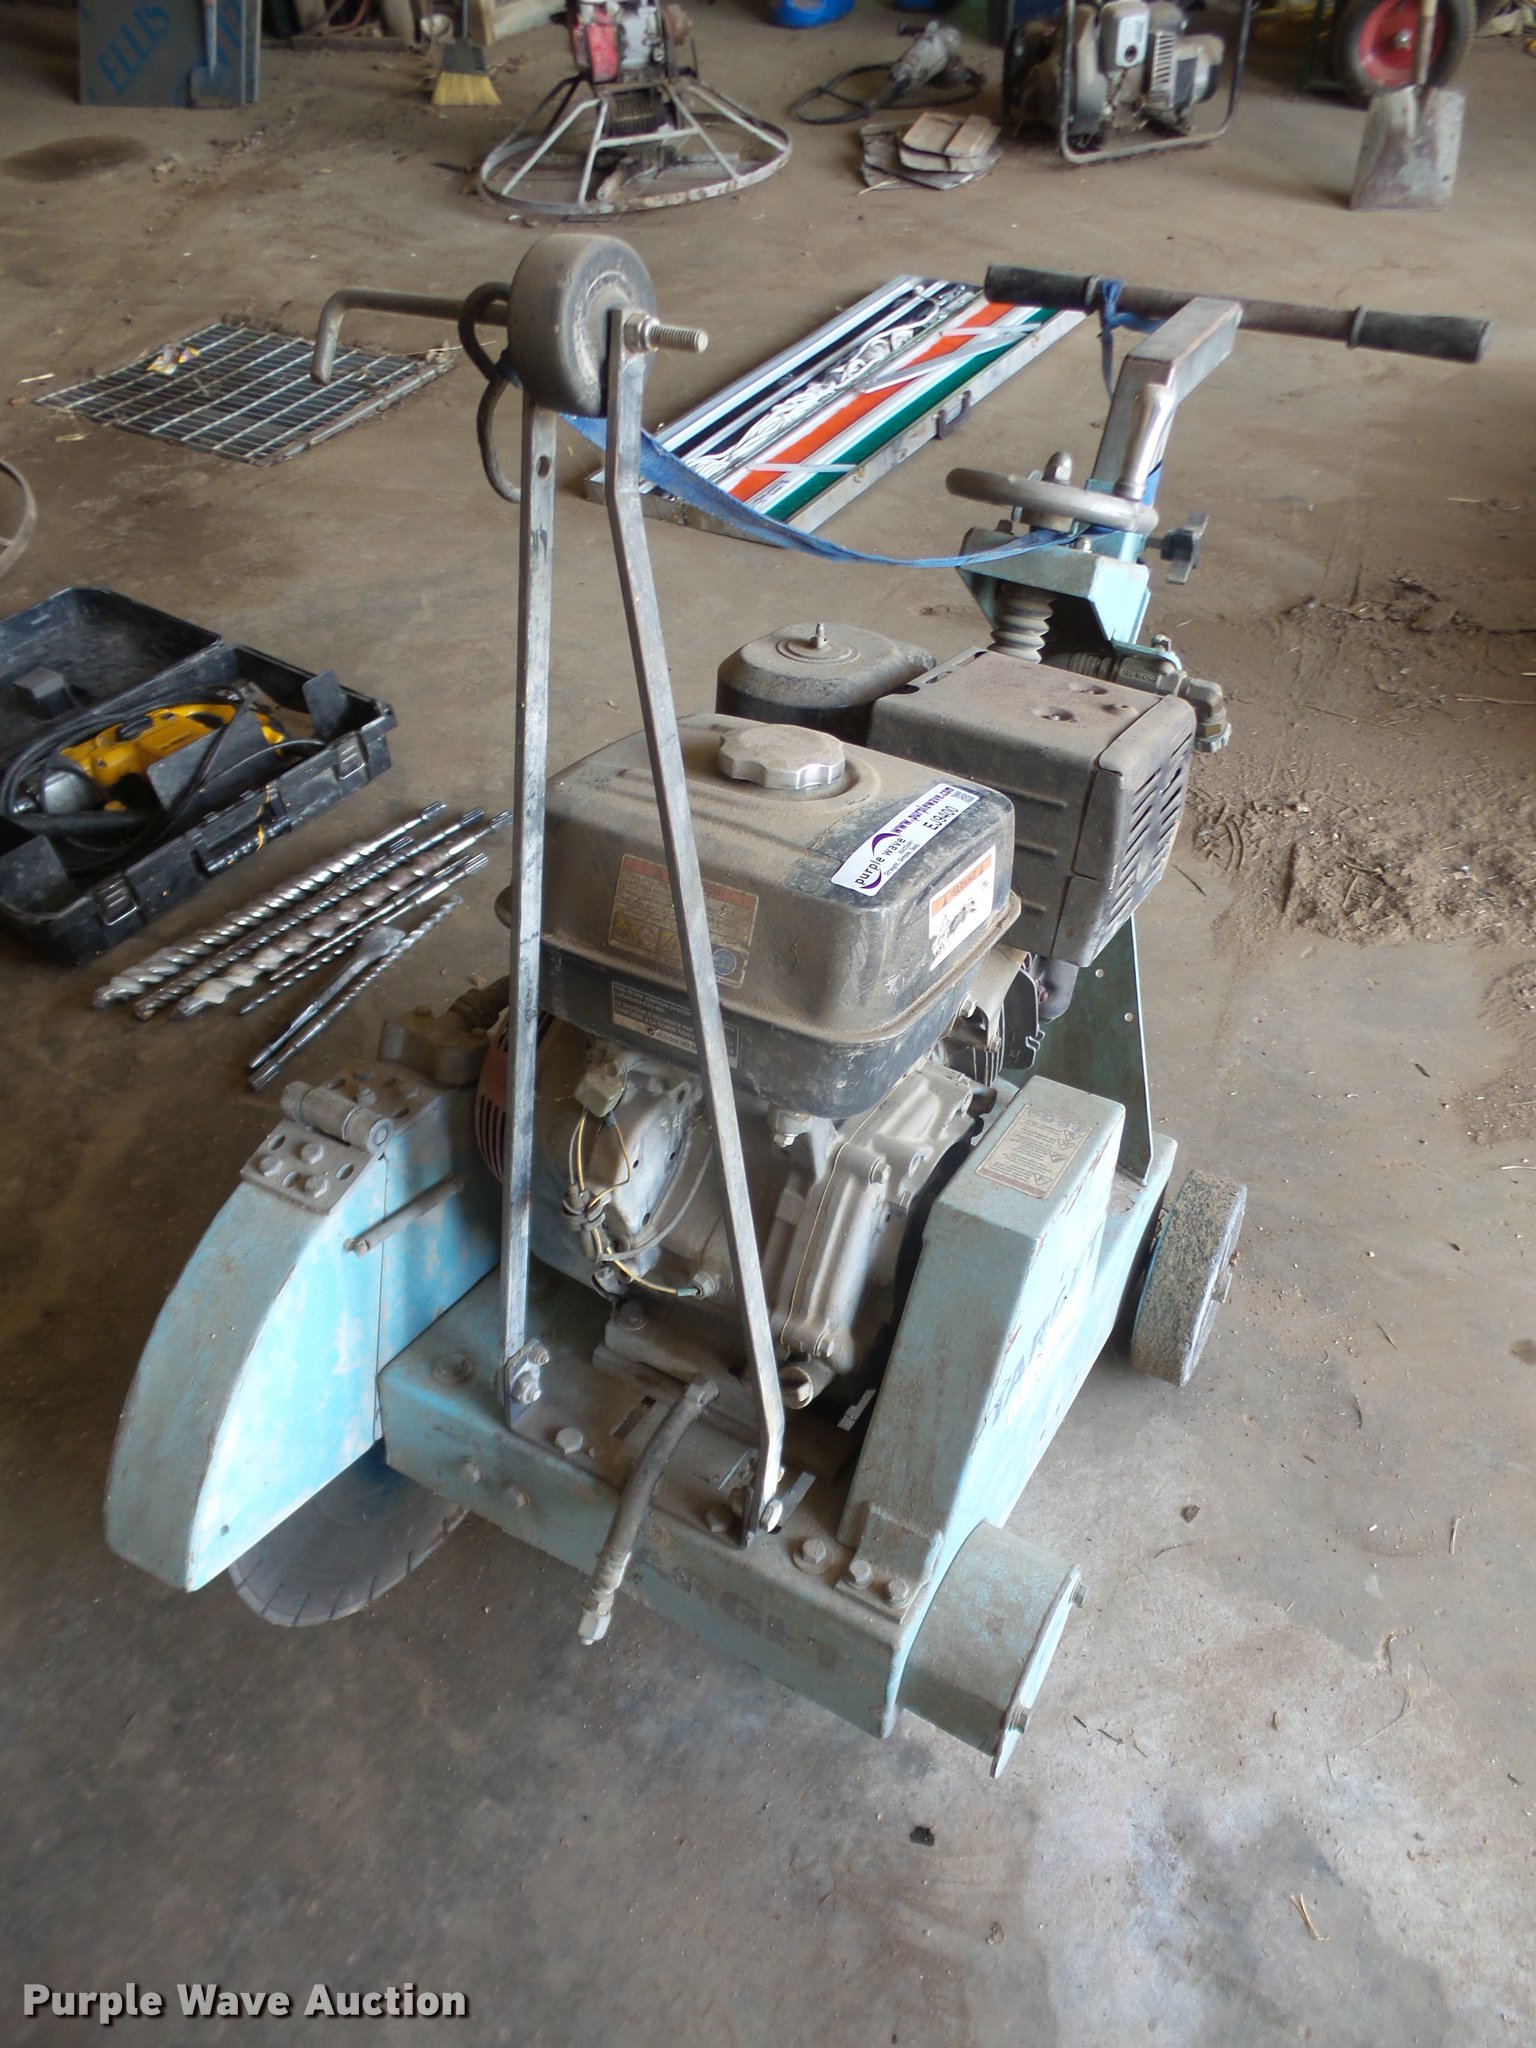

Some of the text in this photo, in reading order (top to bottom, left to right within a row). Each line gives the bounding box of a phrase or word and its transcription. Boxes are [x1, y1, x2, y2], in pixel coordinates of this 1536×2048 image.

[98, 0, 170, 95] ELLIS
[854, 838, 906, 886] purple wave
